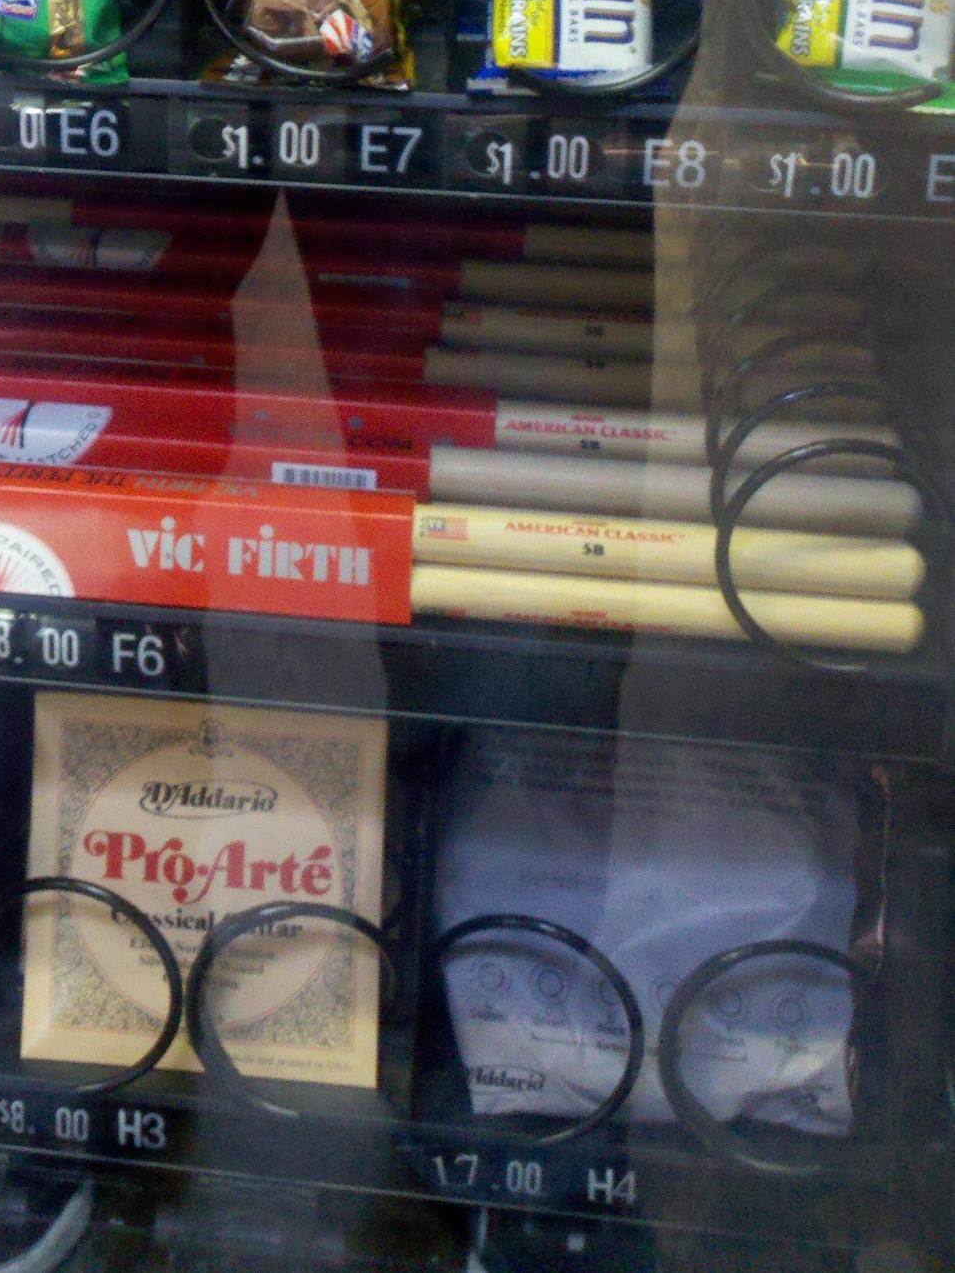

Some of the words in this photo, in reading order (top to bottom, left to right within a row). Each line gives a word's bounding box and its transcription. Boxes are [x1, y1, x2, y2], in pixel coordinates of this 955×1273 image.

[59, 107, 120, 158] E6
[359, 127, 423, 175] E7
[643, 138, 707, 190] E8
[503, 518, 602, 540] AMERICAN
[111, 632, 166, 677] F6
[117, 1108, 167, 1149] H3
[586, 1168, 638, 1205] H4
